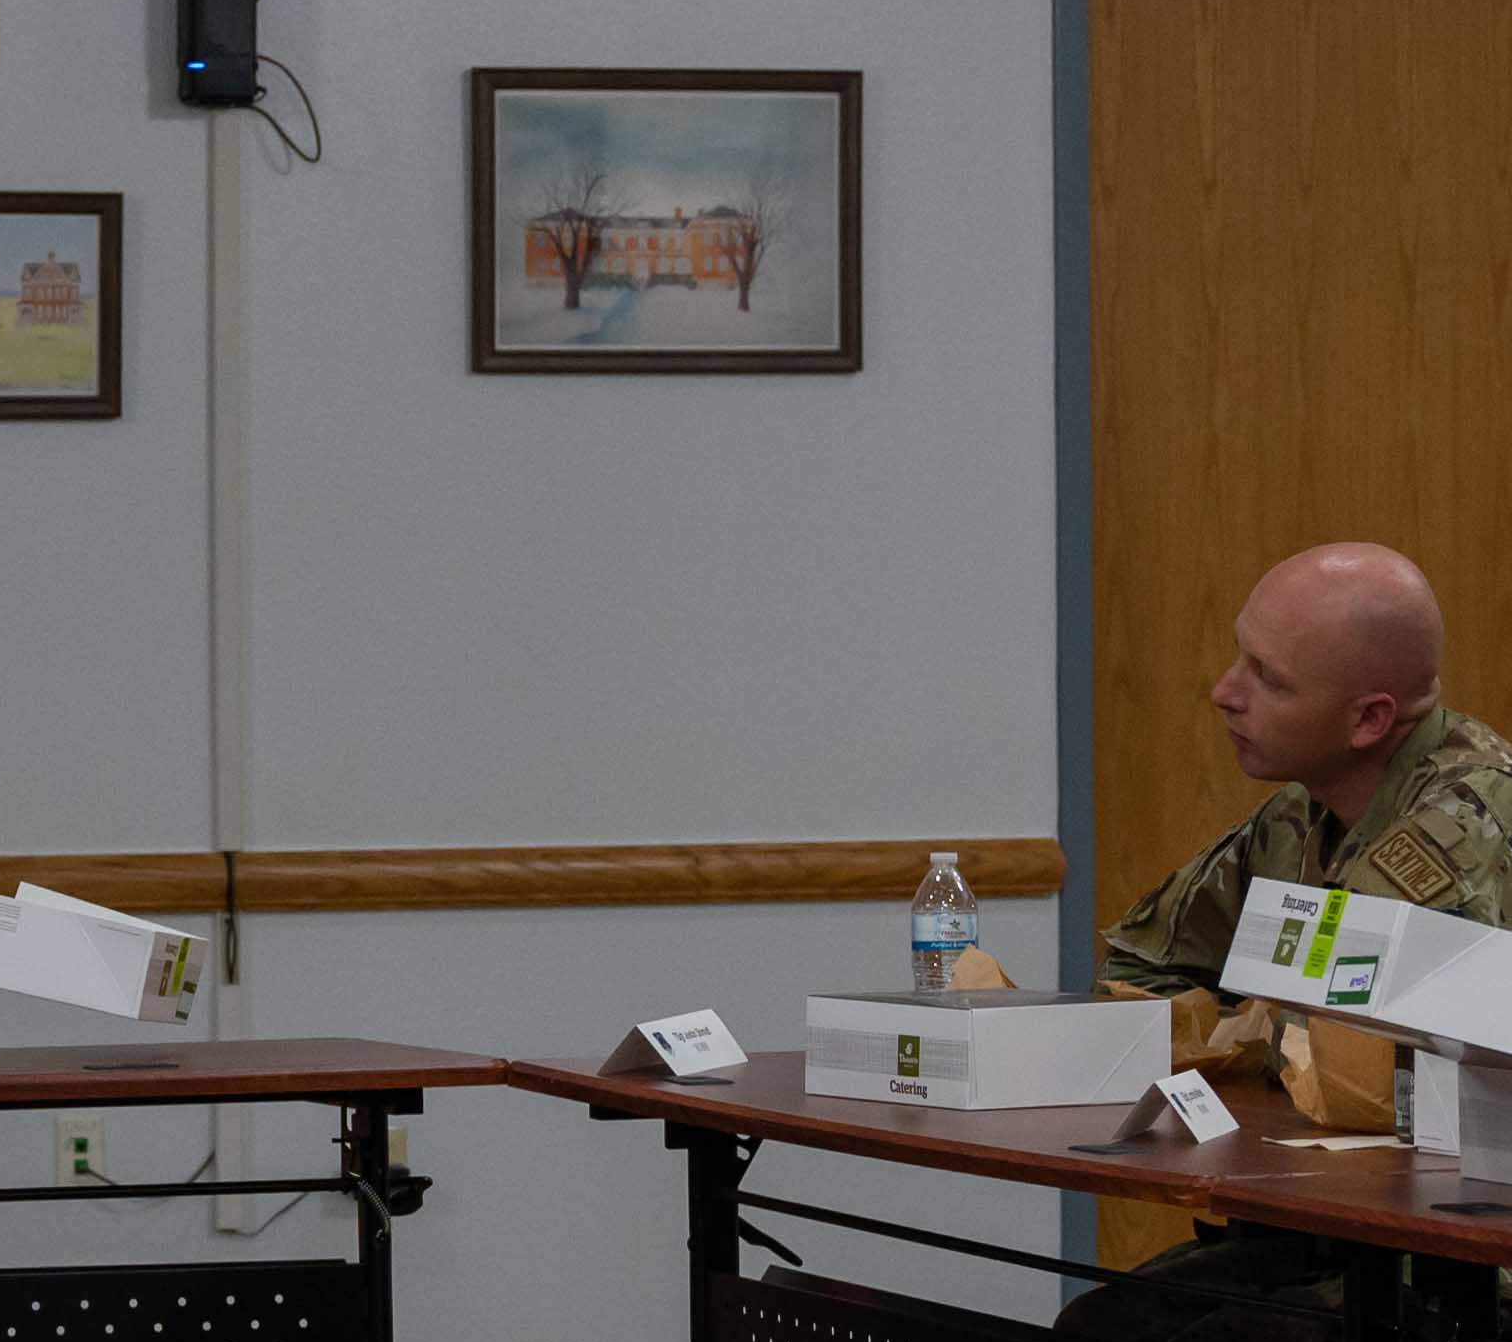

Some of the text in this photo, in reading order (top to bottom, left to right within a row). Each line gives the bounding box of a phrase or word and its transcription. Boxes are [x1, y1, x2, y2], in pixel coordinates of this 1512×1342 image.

[1378, 836, 1442, 898] SENTINEL
[1281, 893, 1319, 916] Catering
[890, 1079, 928, 1099] Catering
